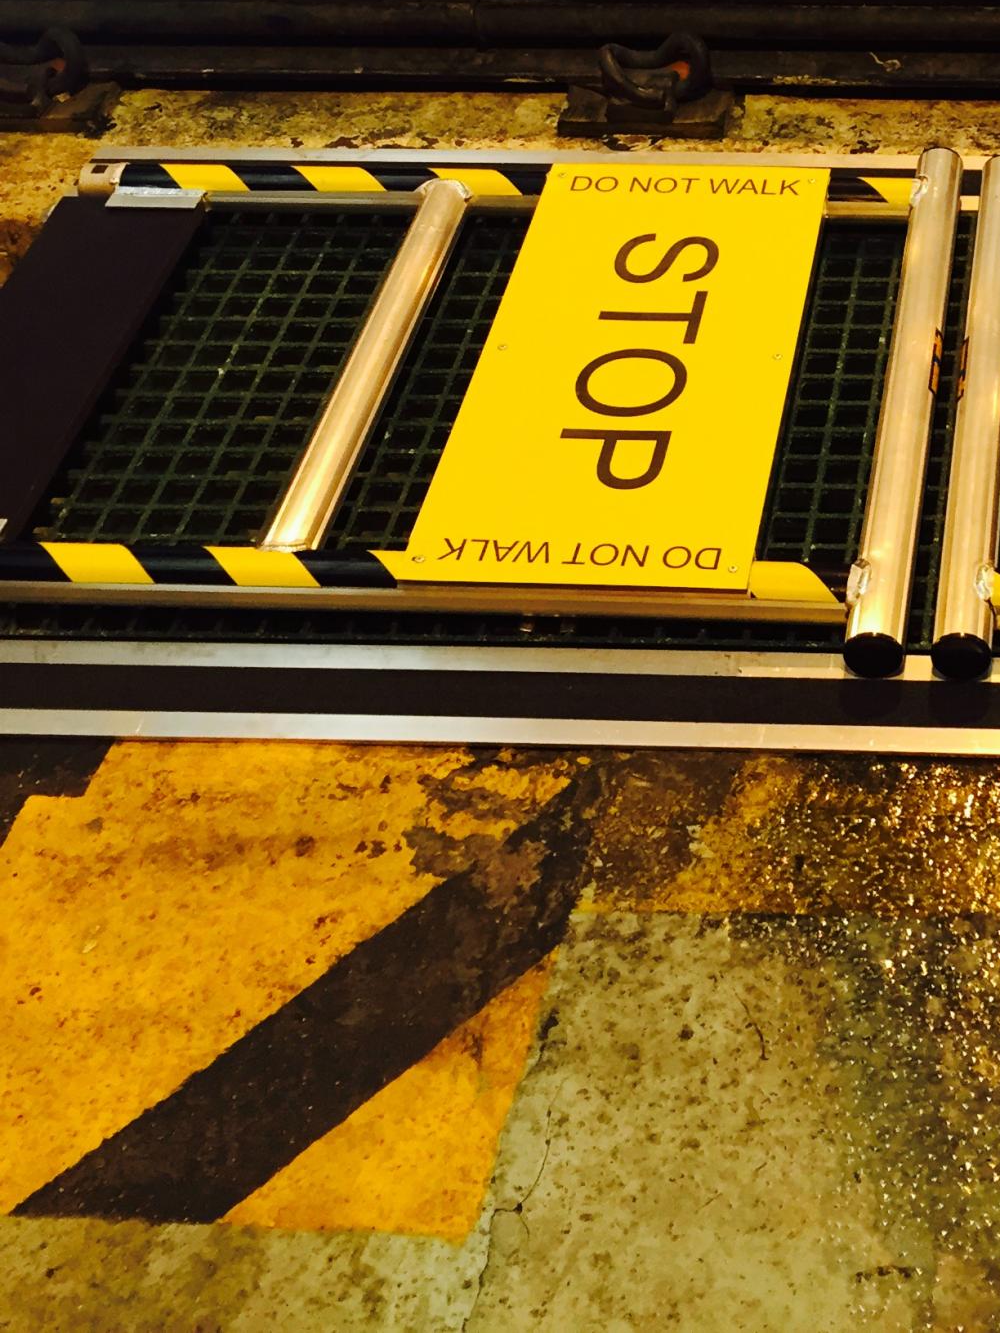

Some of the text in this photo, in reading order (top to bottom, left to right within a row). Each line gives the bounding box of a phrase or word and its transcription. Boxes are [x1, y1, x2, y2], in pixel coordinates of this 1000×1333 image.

[571, 176, 799, 195] DO NOT WALK
[560, 234, 719, 490] STOP
[438, 538, 721, 570] DO NOT WALK
